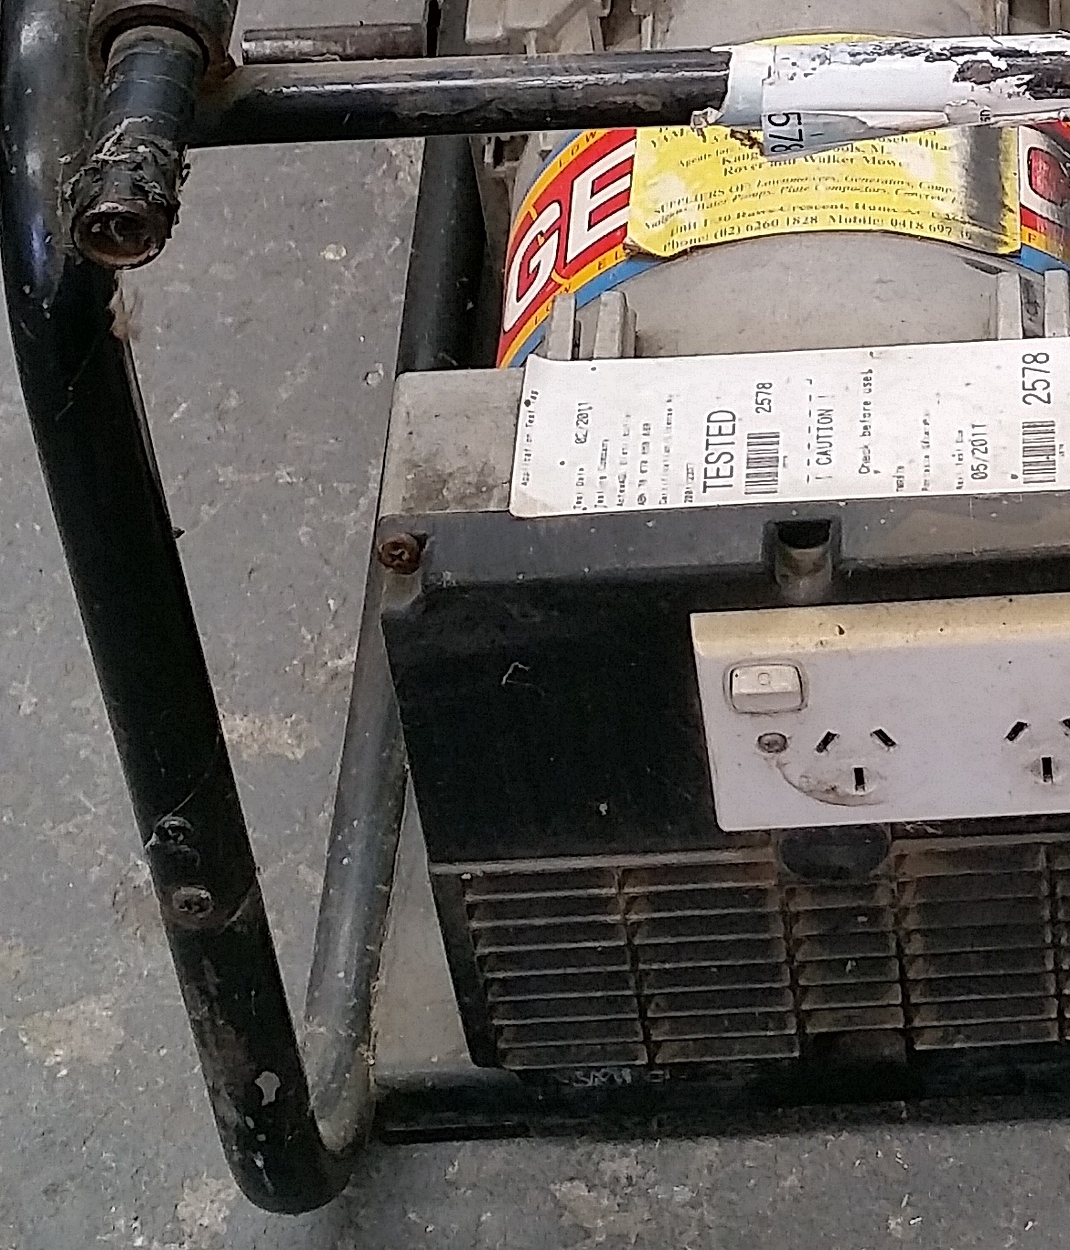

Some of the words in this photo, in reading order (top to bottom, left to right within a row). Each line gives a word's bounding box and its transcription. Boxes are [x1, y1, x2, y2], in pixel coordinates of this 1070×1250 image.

[803, 154, 855, 164] Walker
[1021, 352, 1052, 406] 2578
[702, 408, 737, 494] TESTED
[754, 381, 773, 415] 2578
[815, 408, 834, 466] CAUTION
[859, 400, 872, 437] before
[970, 423, 989, 481] 05/2011
